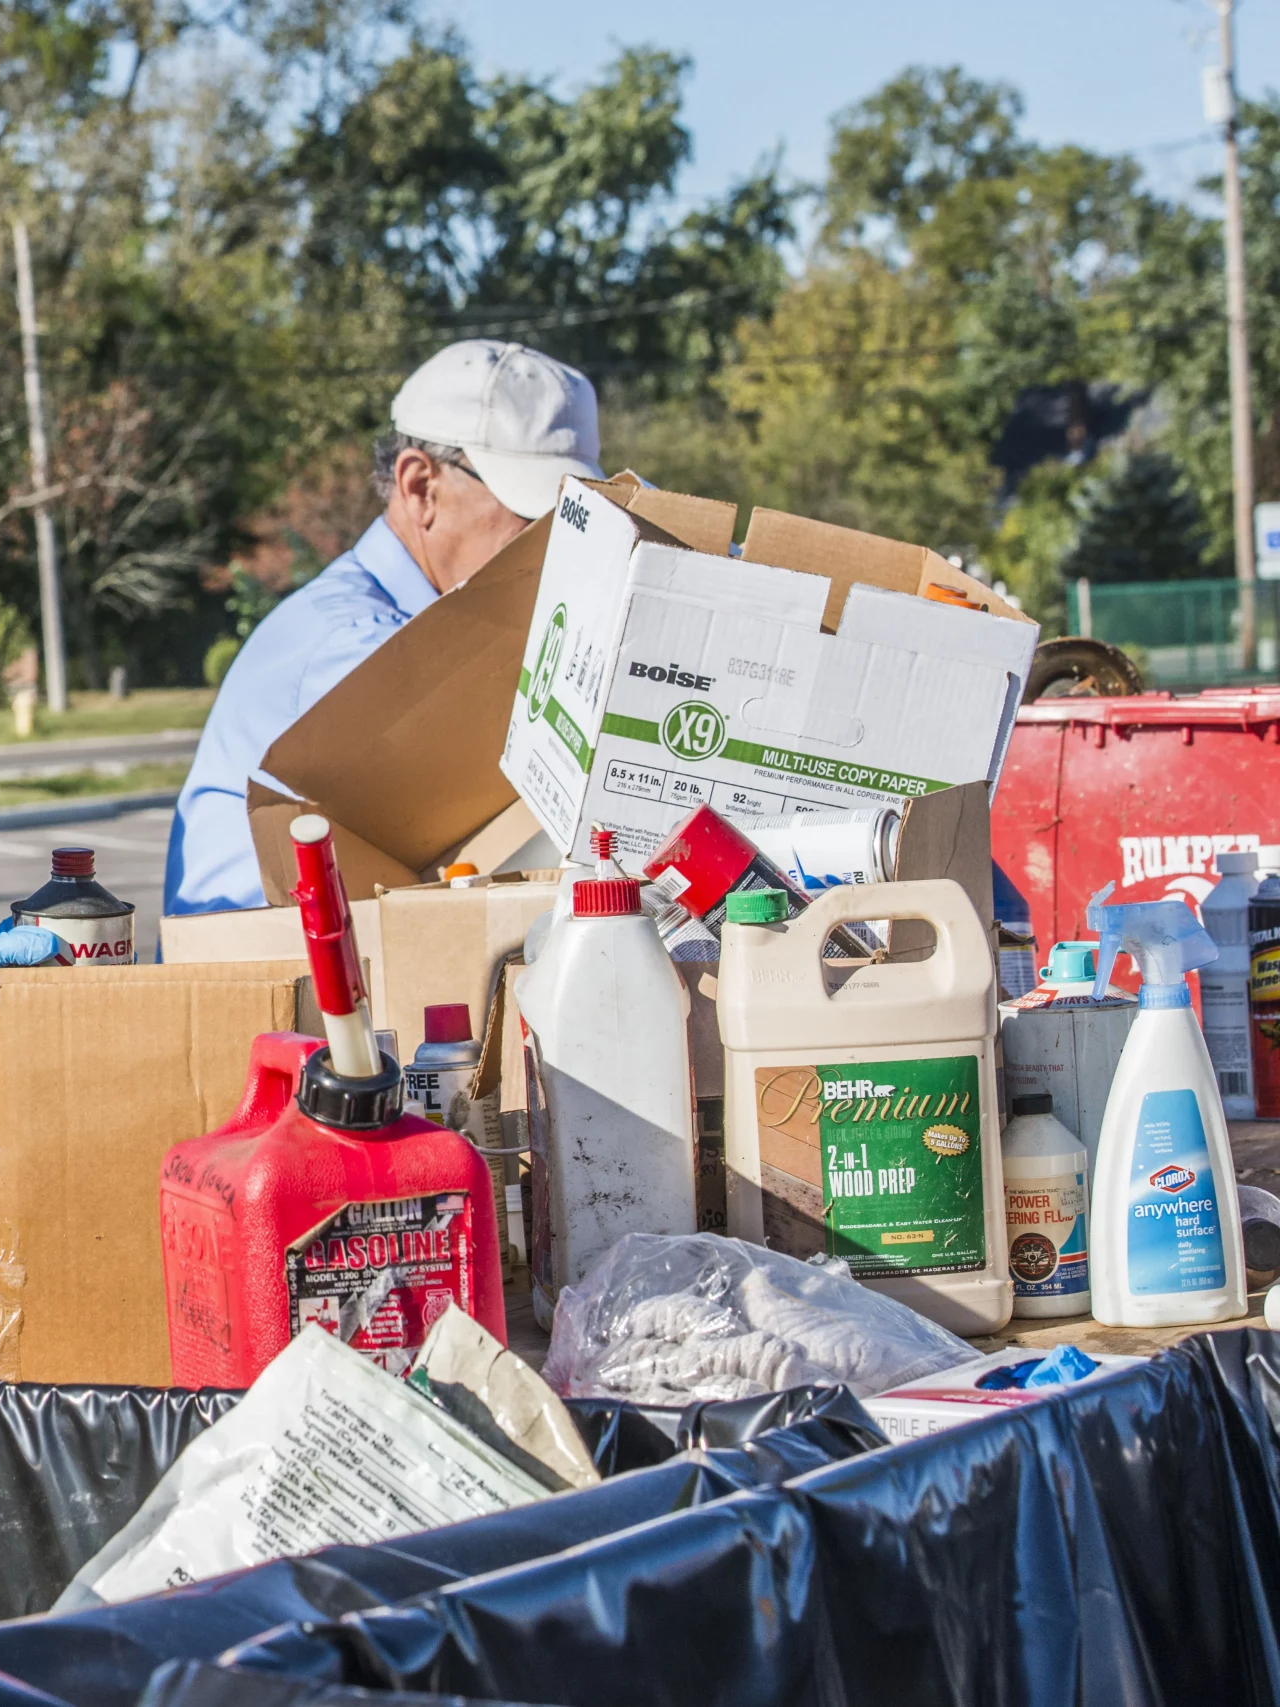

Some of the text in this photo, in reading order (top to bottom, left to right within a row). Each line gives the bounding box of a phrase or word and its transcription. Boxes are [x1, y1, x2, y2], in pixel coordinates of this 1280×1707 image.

[671, 709, 717, 754] X9
[610, 766, 627, 779] 8.5
[638, 772, 649, 784] 11
[649, 775, 662, 787] in.
[761, 749, 927, 797] MULTI-USE COPY PAPER
[673, 779, 703, 795] 20 lb.
[753, 767, 900, 805] PREMIUM PERFORMANCE IN ALL COPIERS AND
[731, 791, 761, 808] 92 bright
[616, 830, 634, 839] ademark
[69, 939, 133, 958] WAGN
[1056, 996, 1090, 1006] STAYS
[1048, 1064, 1064, 1072] THAT
[758, 1068, 970, 1127] Premium
[823, 1079, 874, 1100] BEHR
[884, 1124, 912, 1140] SIDING
[927, 1131, 966, 1143] Makes Up To
[936, 1140, 963, 1150] GALLONS
[827, 1143, 868, 1171] 2-IN-1
[828, 1167, 916, 1198] WOOD PREP
[1154, 1168, 1191, 1190] CLOROX
[1009, 1195, 1050, 1208] POWER
[1134, 1197, 1213, 1220] anywhere
[1005, 1209, 1074, 1225] ERING FLU
[1175, 1214, 1200, 1227] hard
[1176, 1225, 1215, 1238] surface
[303, 1229, 451, 1272] GASOLINE
[1177, 1241, 1192, 1249] daily
[1178, 1247, 1206, 1255] sanitizing
[305, 1272, 337, 1282] MODEL
[339, 1271, 359, 1280] 1200
[418, 1262, 453, 1273] SYSTEM
[875, 1416, 920, 1439] TRILE
[367, 1438, 408, 1473] Nitrogen
[326, 1447, 356, 1472] Water
[354, 1467, 388, 1496] Soluble
[300, 1481, 331, 1508] Water
